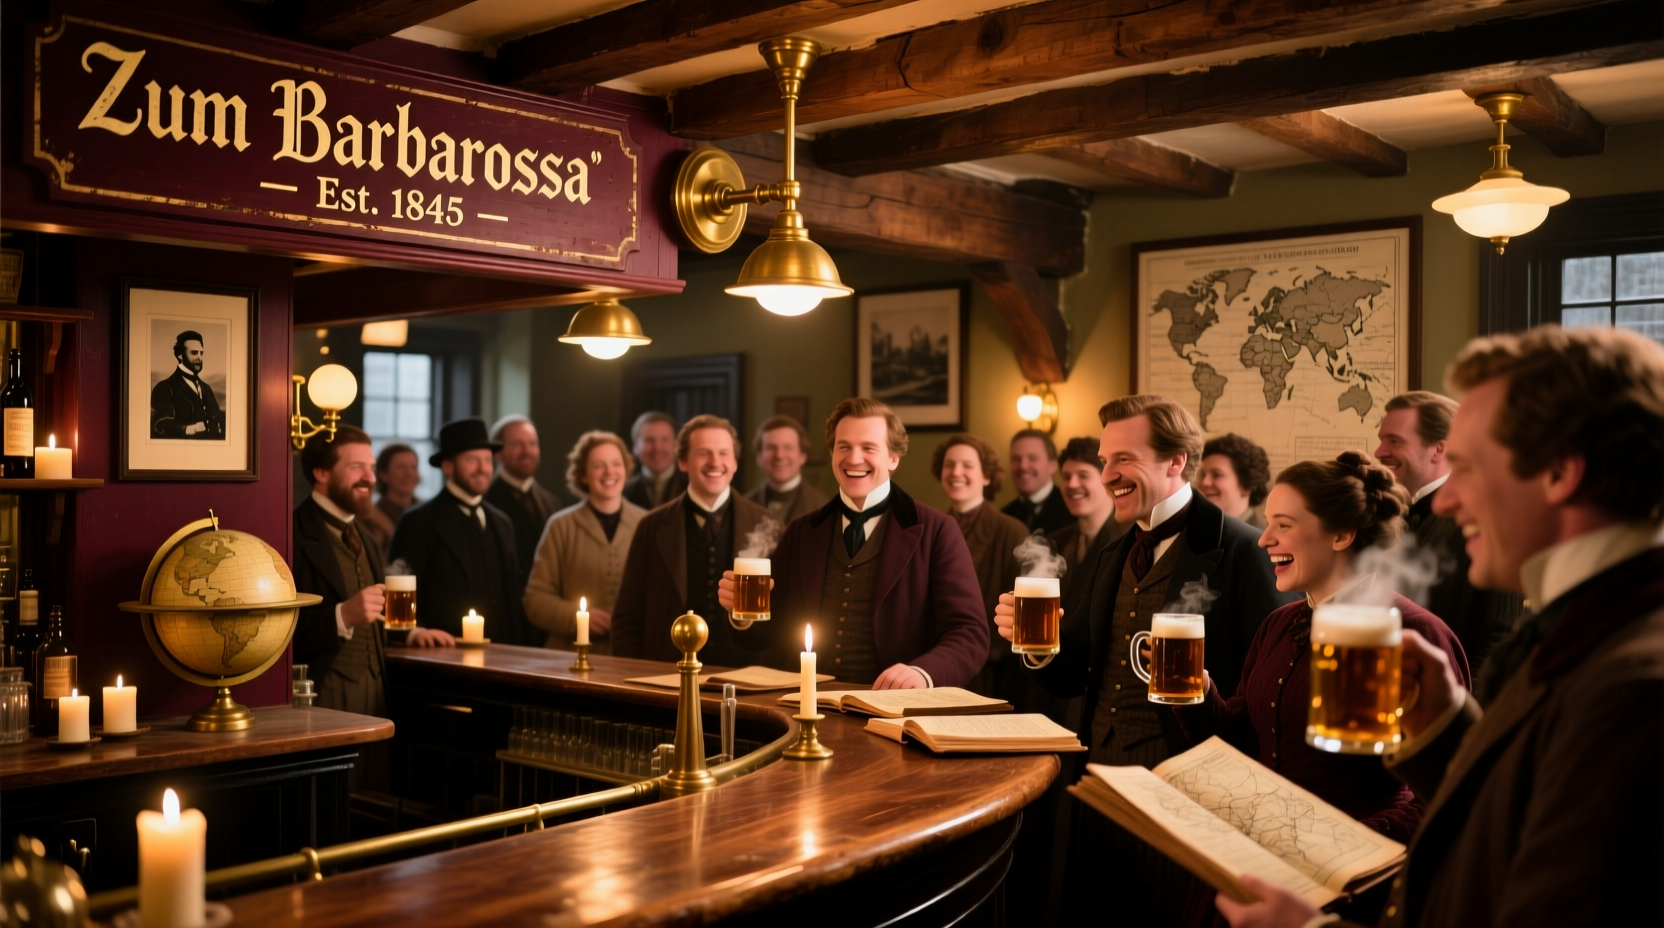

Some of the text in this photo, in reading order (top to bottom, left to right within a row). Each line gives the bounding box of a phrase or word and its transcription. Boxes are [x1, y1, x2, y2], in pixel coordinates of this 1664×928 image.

[78, 42, 252, 153] Zum
[315, 175, 464, 227] Est. 1845
